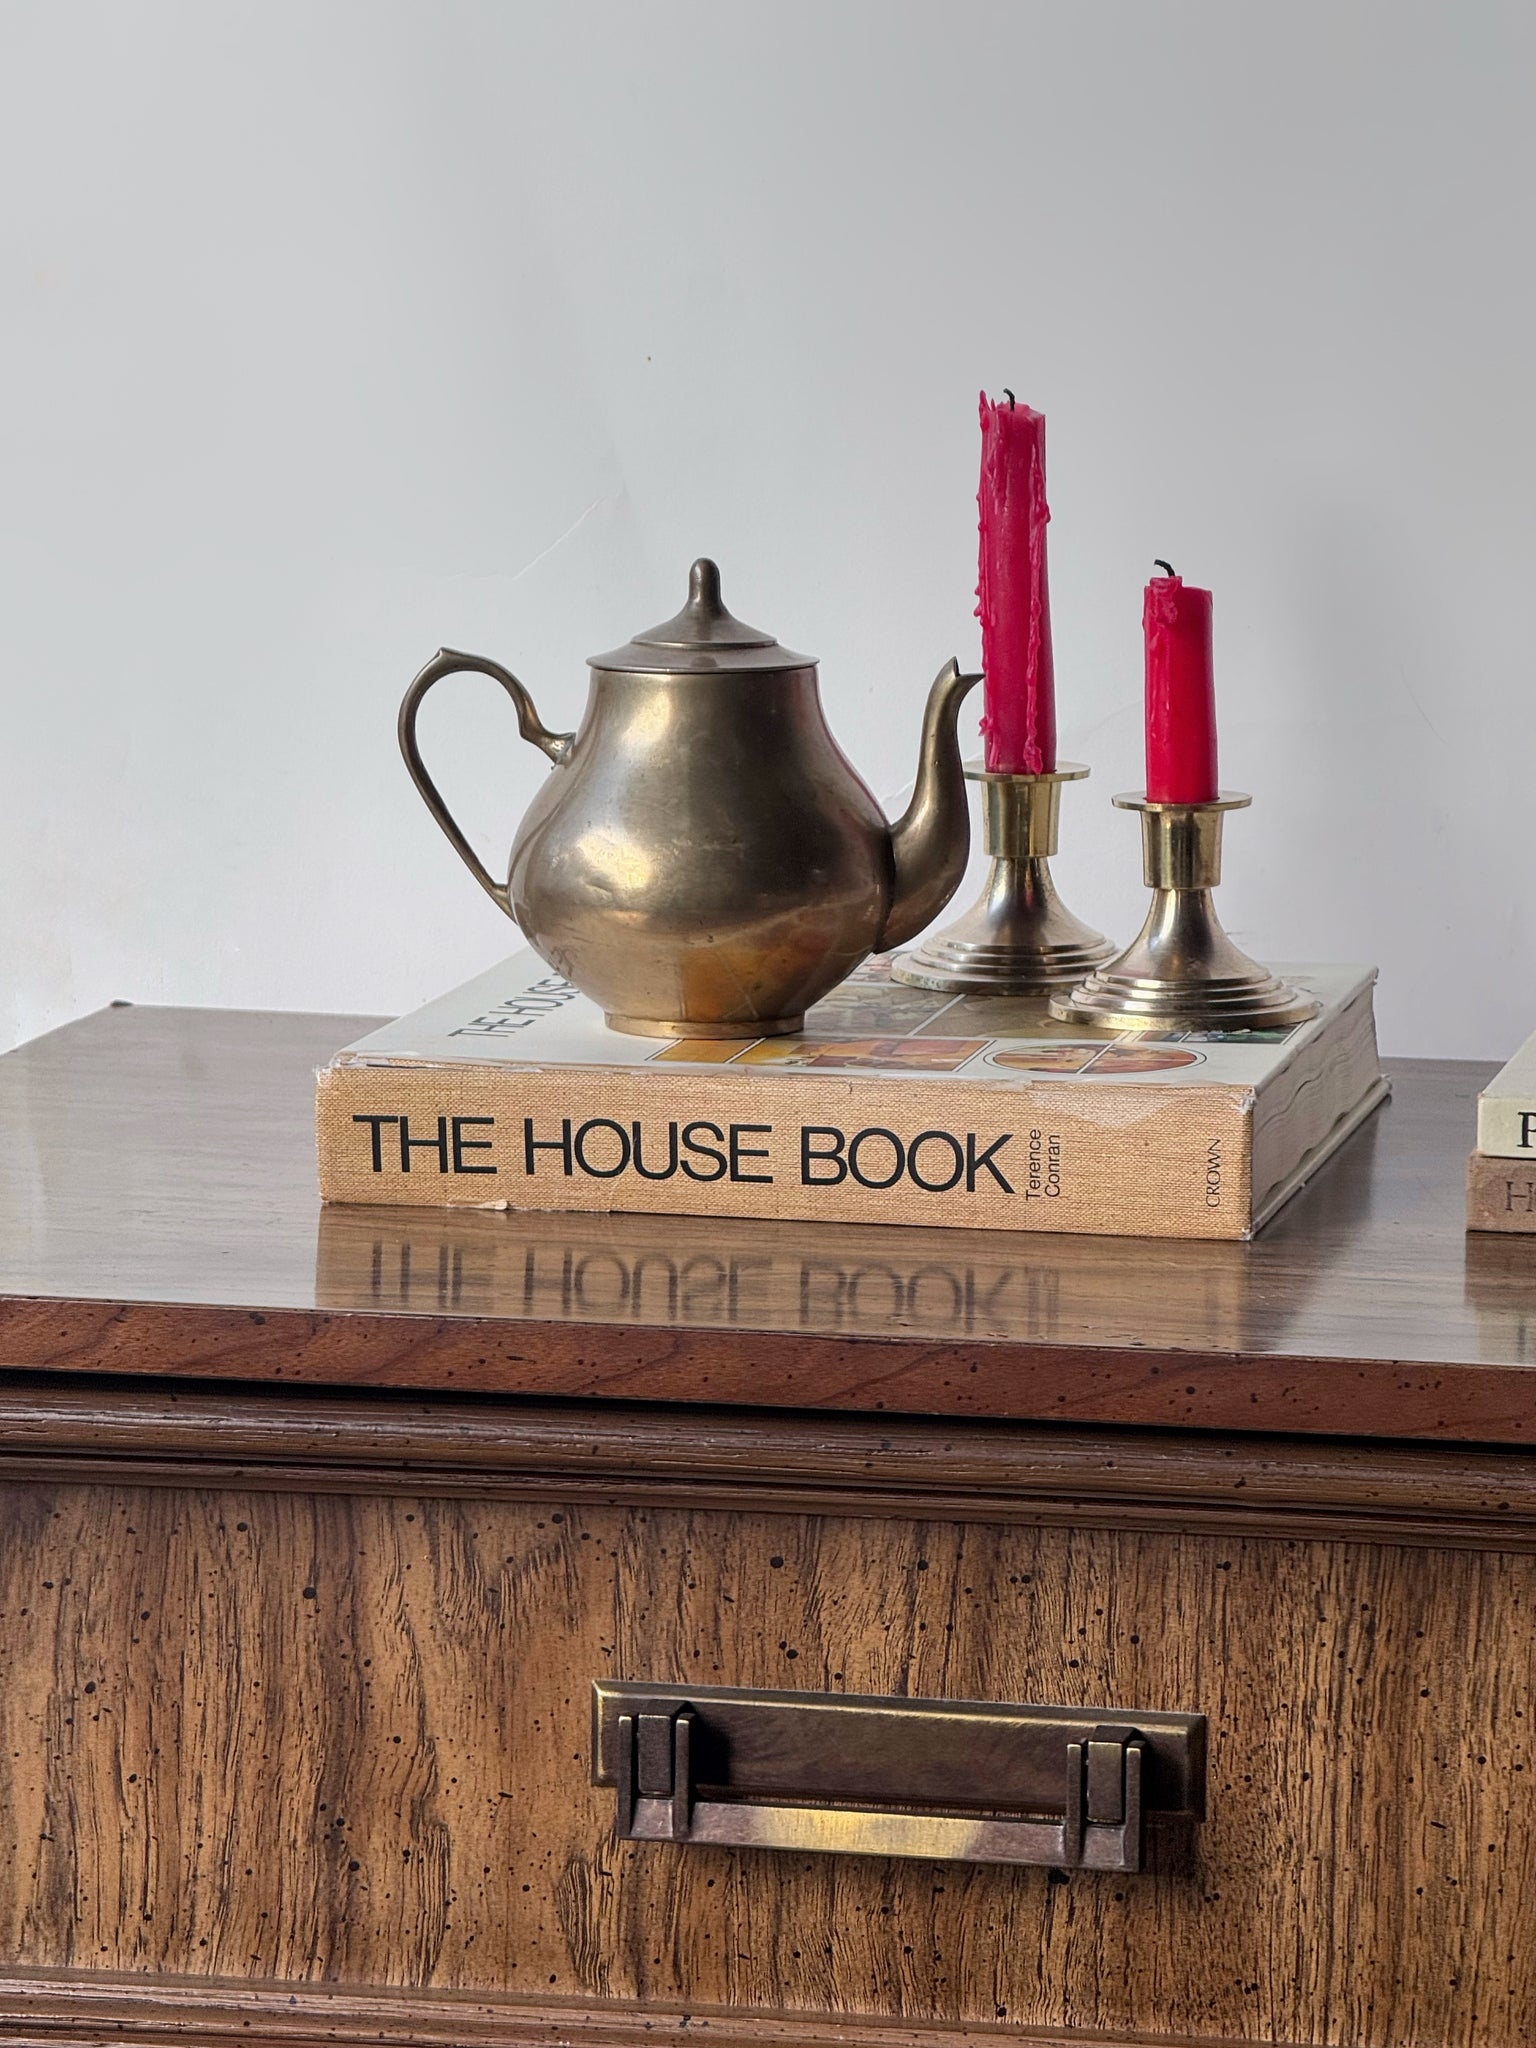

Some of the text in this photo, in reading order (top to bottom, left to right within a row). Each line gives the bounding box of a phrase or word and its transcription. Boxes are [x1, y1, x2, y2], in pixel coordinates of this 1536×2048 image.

[448, 1016, 536, 1037] THE
[352, 1114, 1016, 1195] THE HOUSE BOOK
[1025, 1128, 1042, 1201] Terence
[1044, 1133, 1061, 1198] Conran
[1205, 1138, 1222, 1208] CROWN
